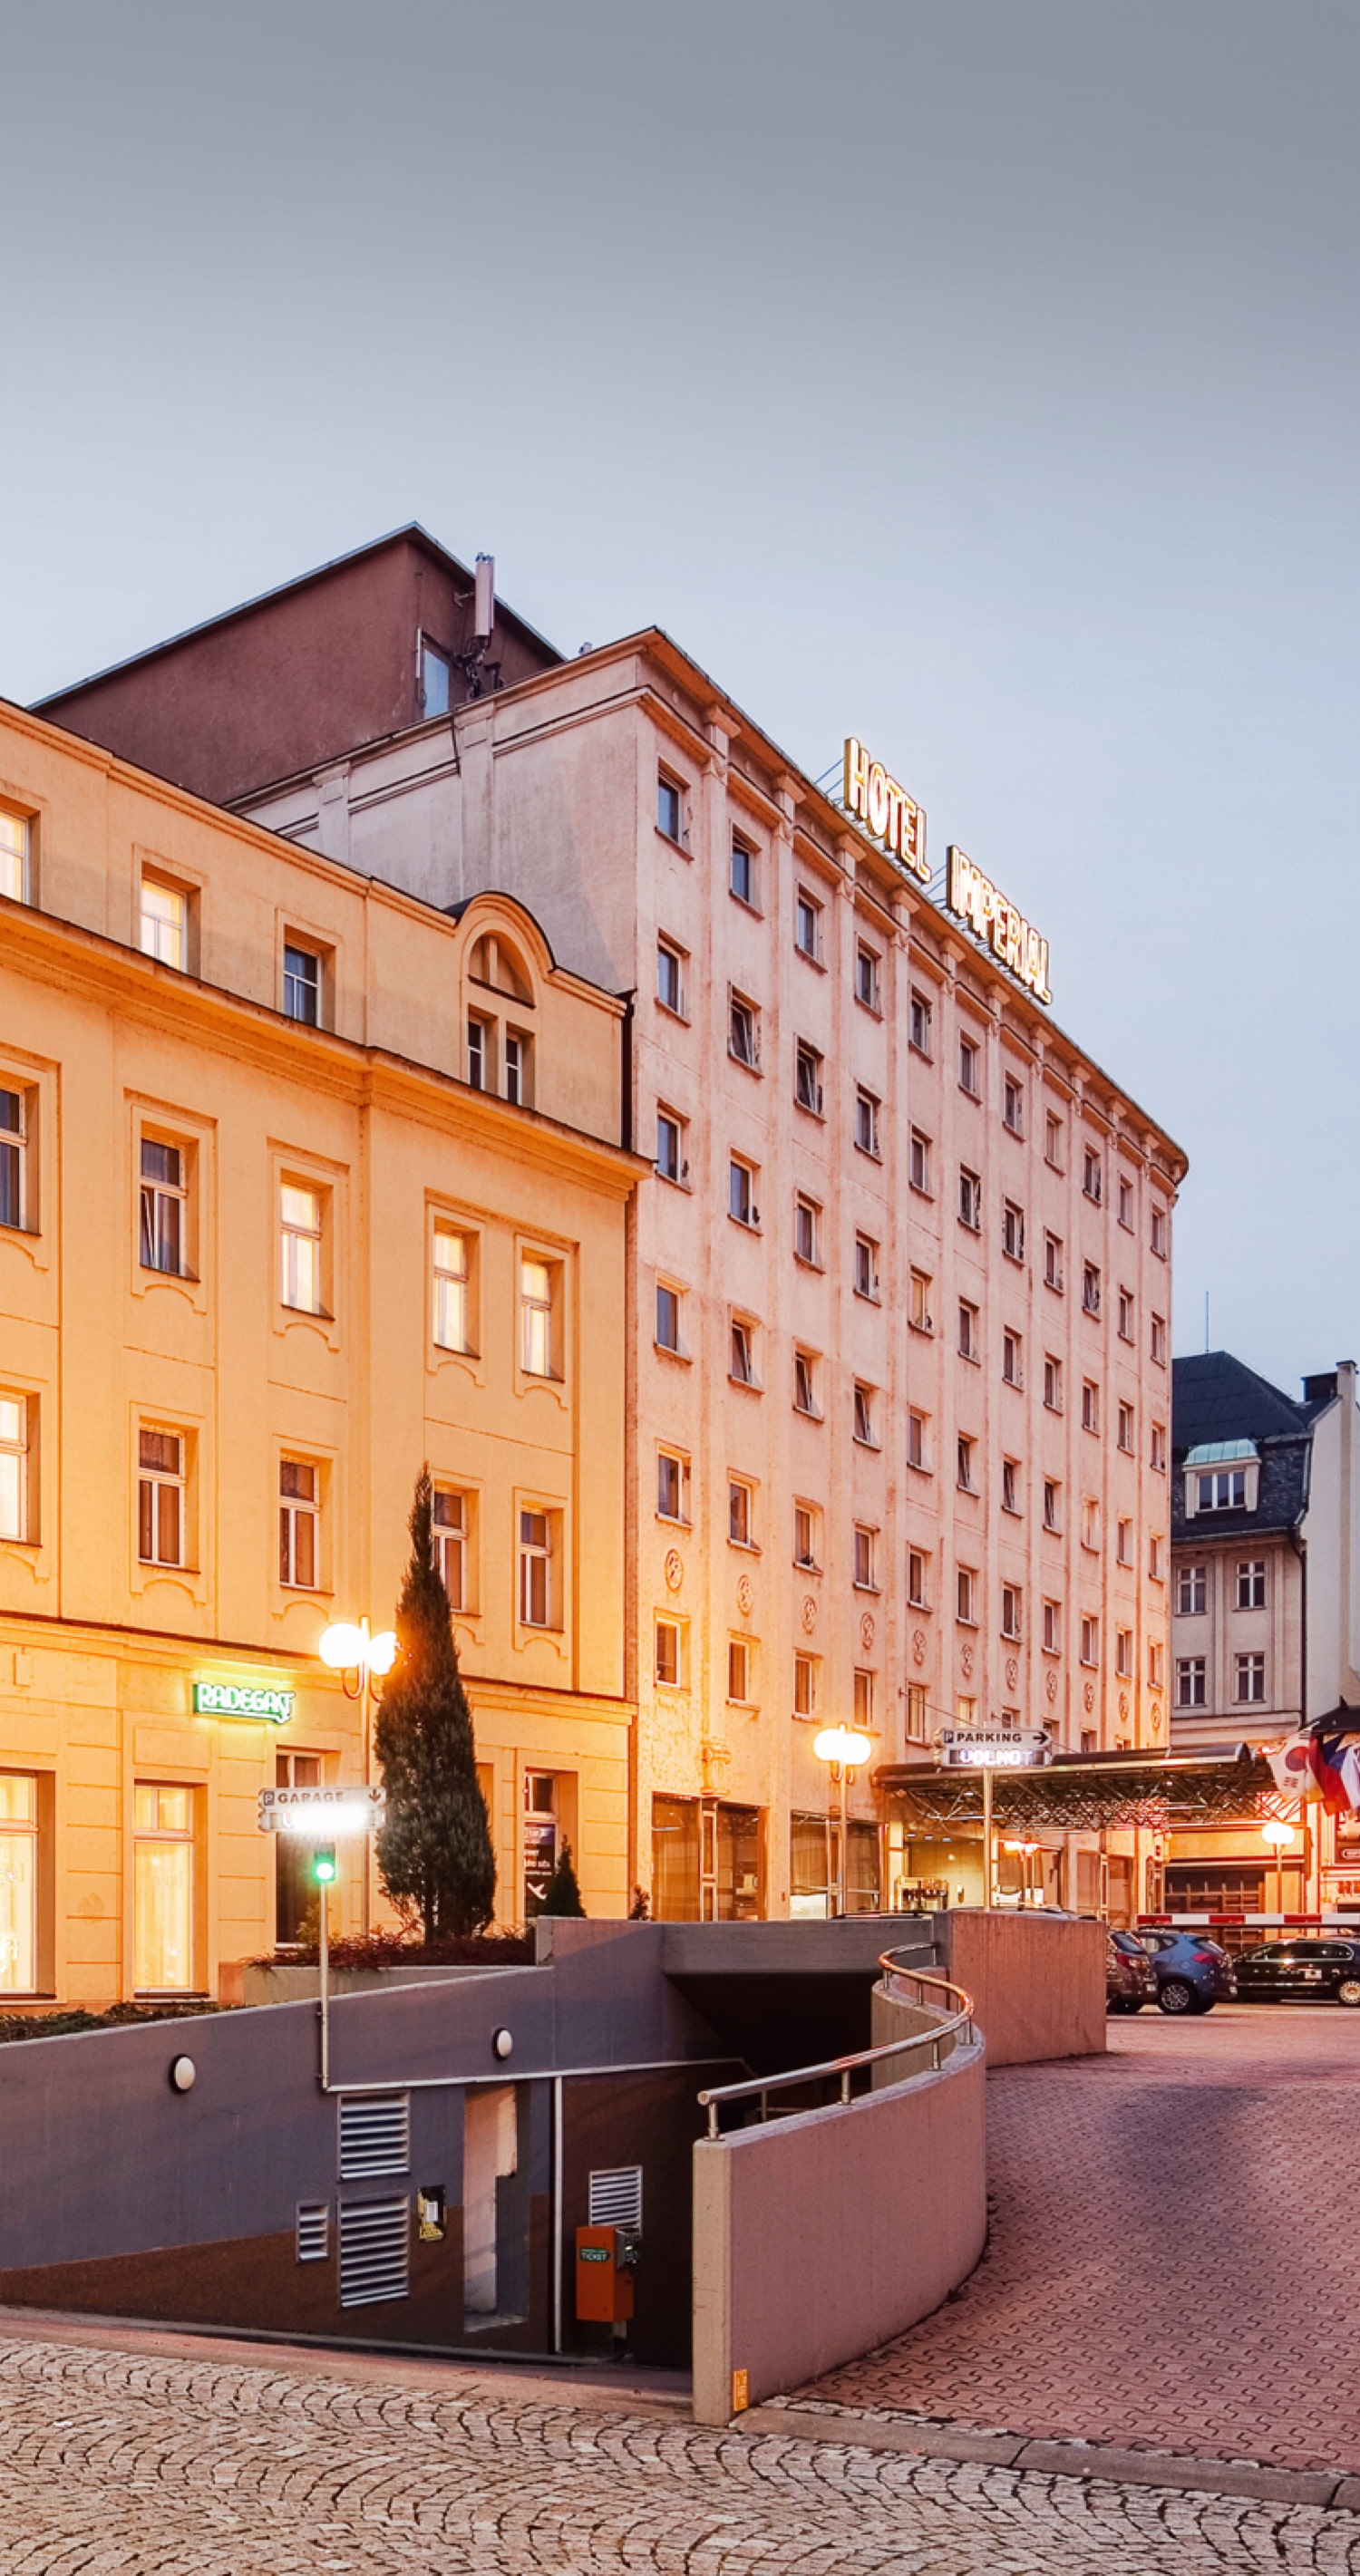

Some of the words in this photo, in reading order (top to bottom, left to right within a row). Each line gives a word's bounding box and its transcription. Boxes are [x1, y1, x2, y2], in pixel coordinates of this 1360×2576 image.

[844, 738, 931, 884] HOTEL
[947, 845, 1052, 1004] IMPERIAL
[957, 1732, 1023, 1742] PARKING
[277, 1792, 344, 1804] GARAGE
